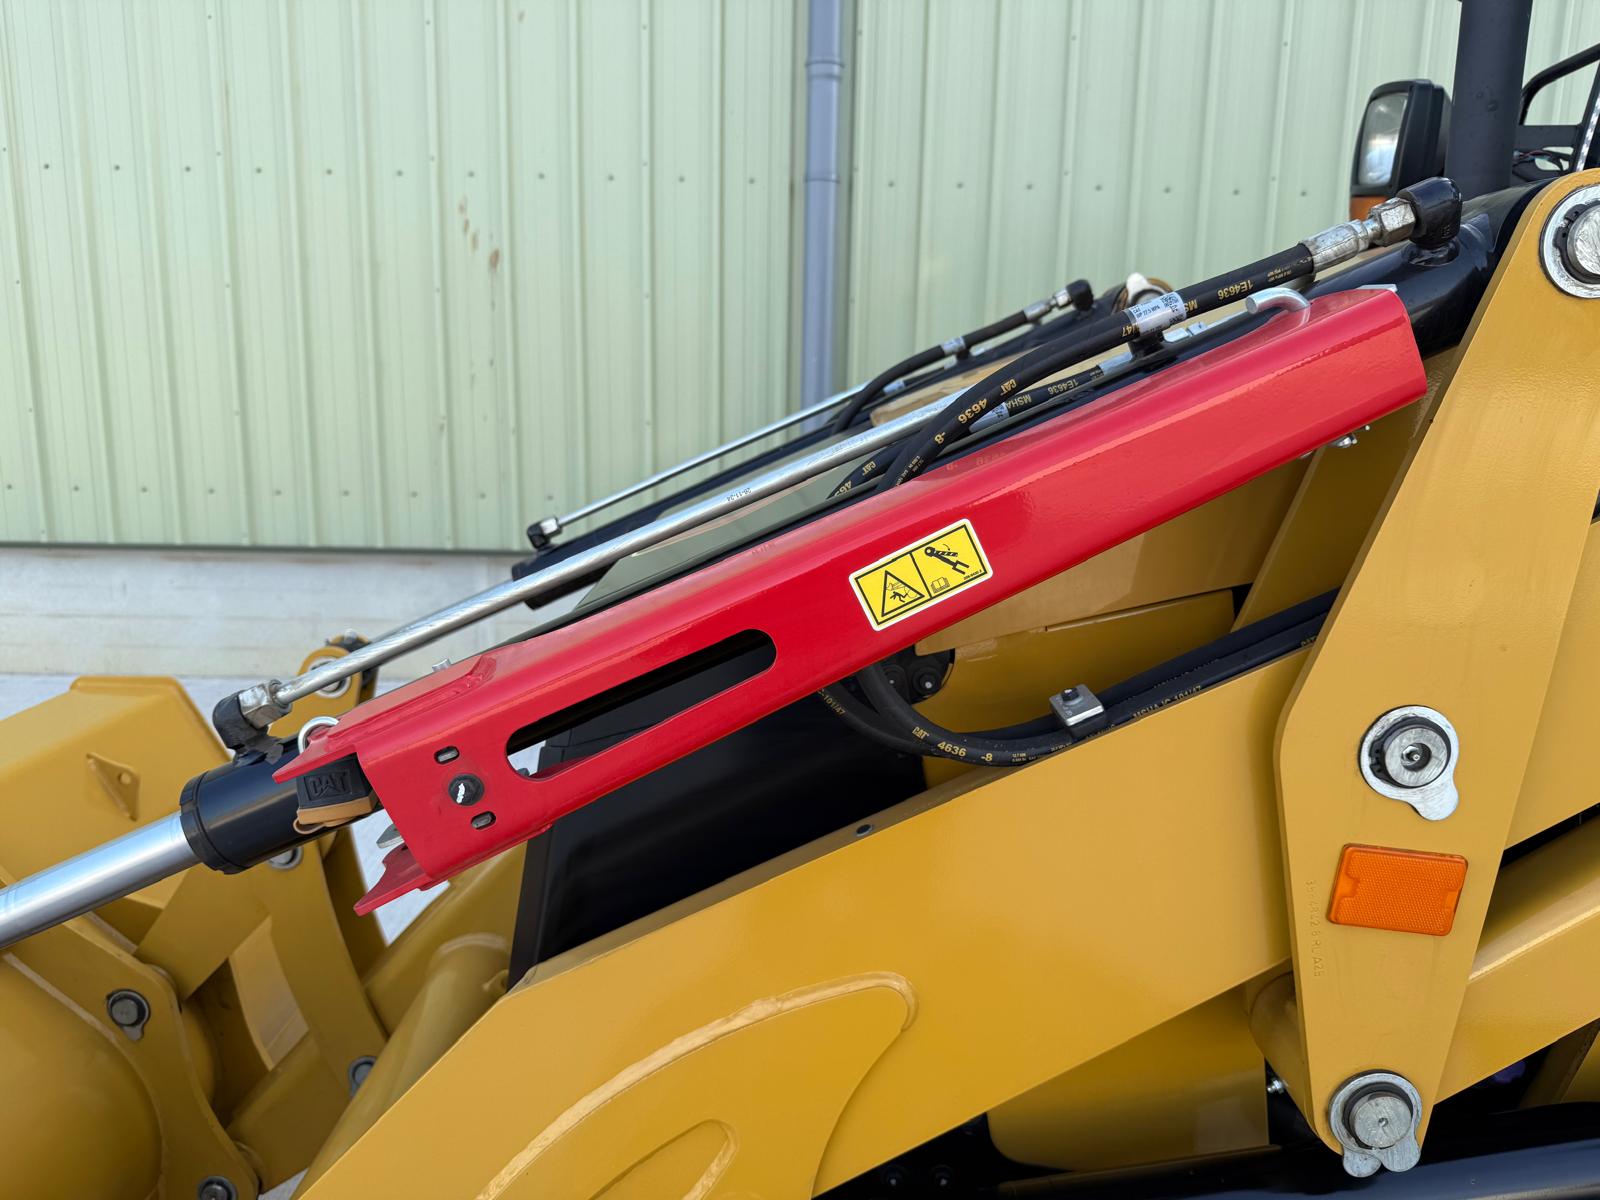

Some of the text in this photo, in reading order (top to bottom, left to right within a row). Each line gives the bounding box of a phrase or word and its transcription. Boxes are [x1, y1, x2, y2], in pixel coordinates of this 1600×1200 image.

[1217, 280, 1254, 300] 1E4636
[1001, 379, 1017, 395] CAT
[1005, 378, 1079, 409] 1E4636 MSHA
[958, 398, 987, 424] 4636
[934, 432, 946, 444] -8
[862, 460, 876, 476] CAT
[911, 727, 993, 762] CAT 4636 -8
[308, 769, 347, 797] CAT
